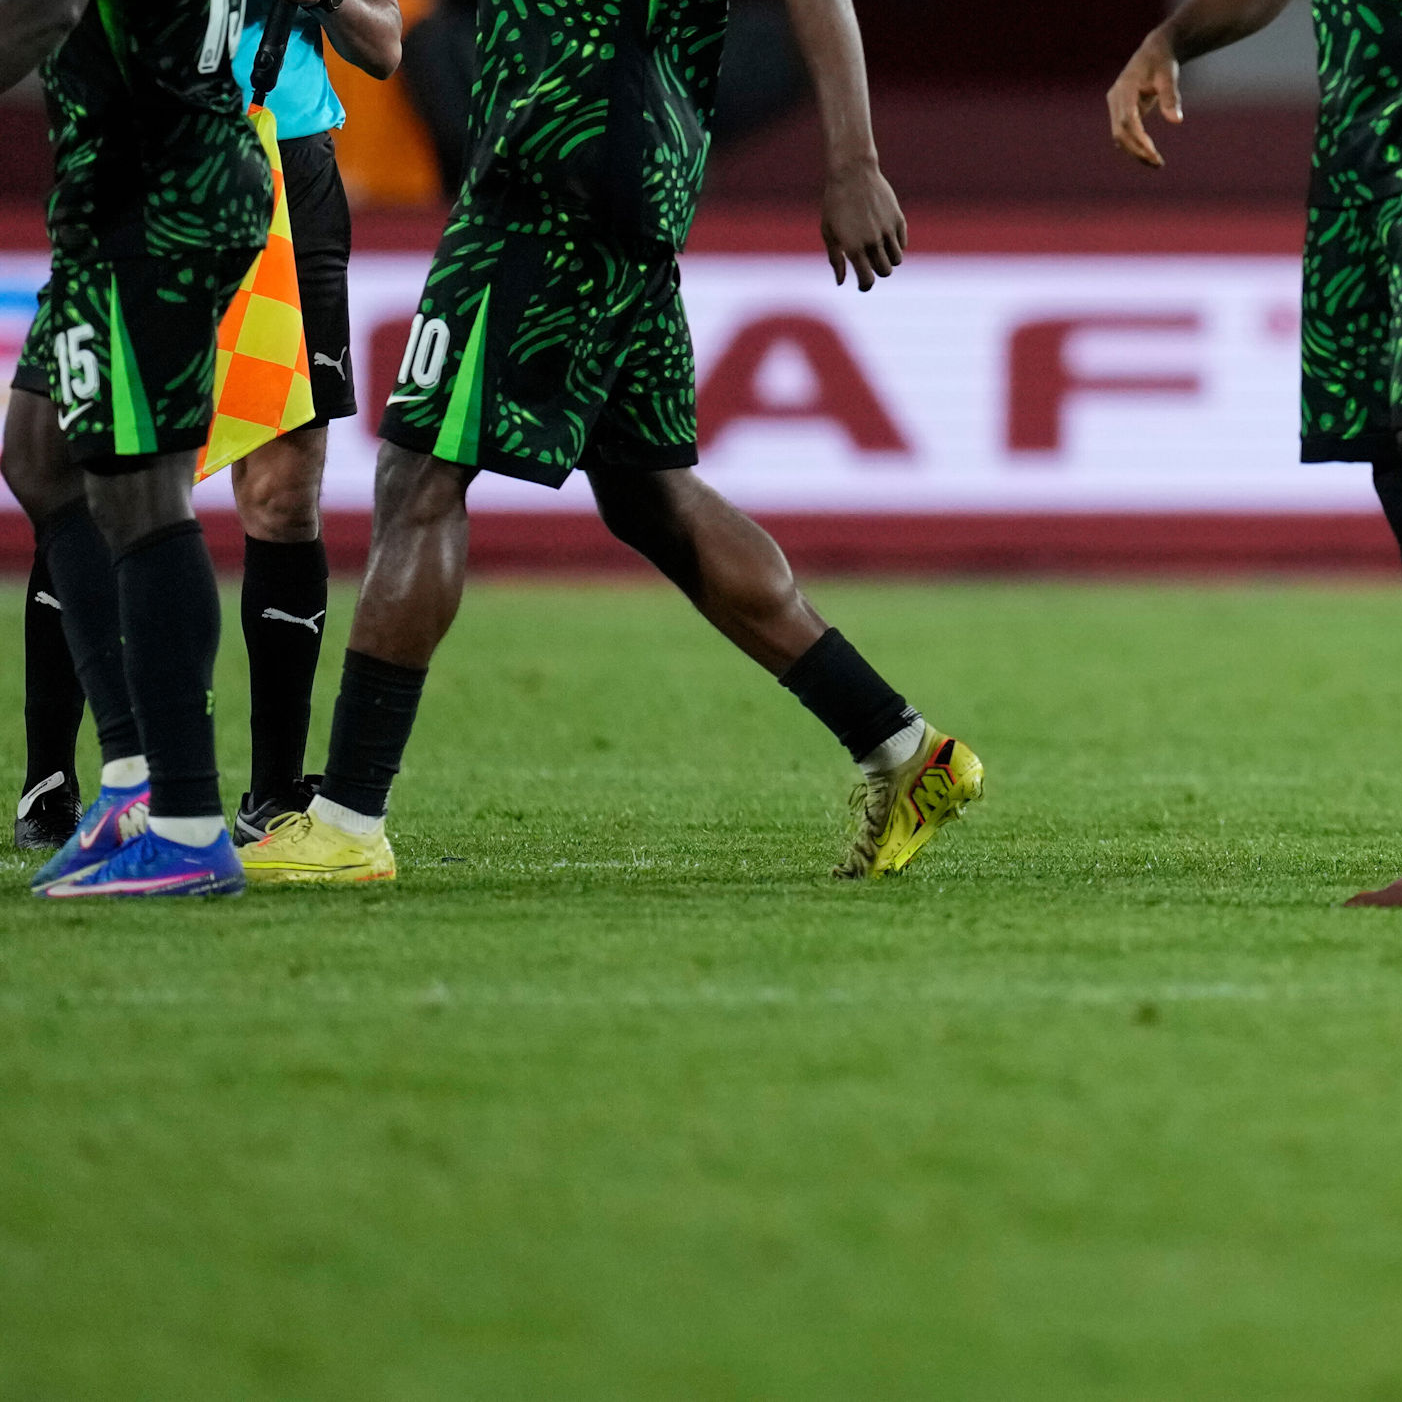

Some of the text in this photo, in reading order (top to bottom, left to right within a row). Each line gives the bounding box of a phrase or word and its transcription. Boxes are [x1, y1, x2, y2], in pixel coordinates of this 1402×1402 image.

[54, 323, 100, 405] 15
[364, 302, 1206, 458] AF
[397, 312, 451, 388] 10
